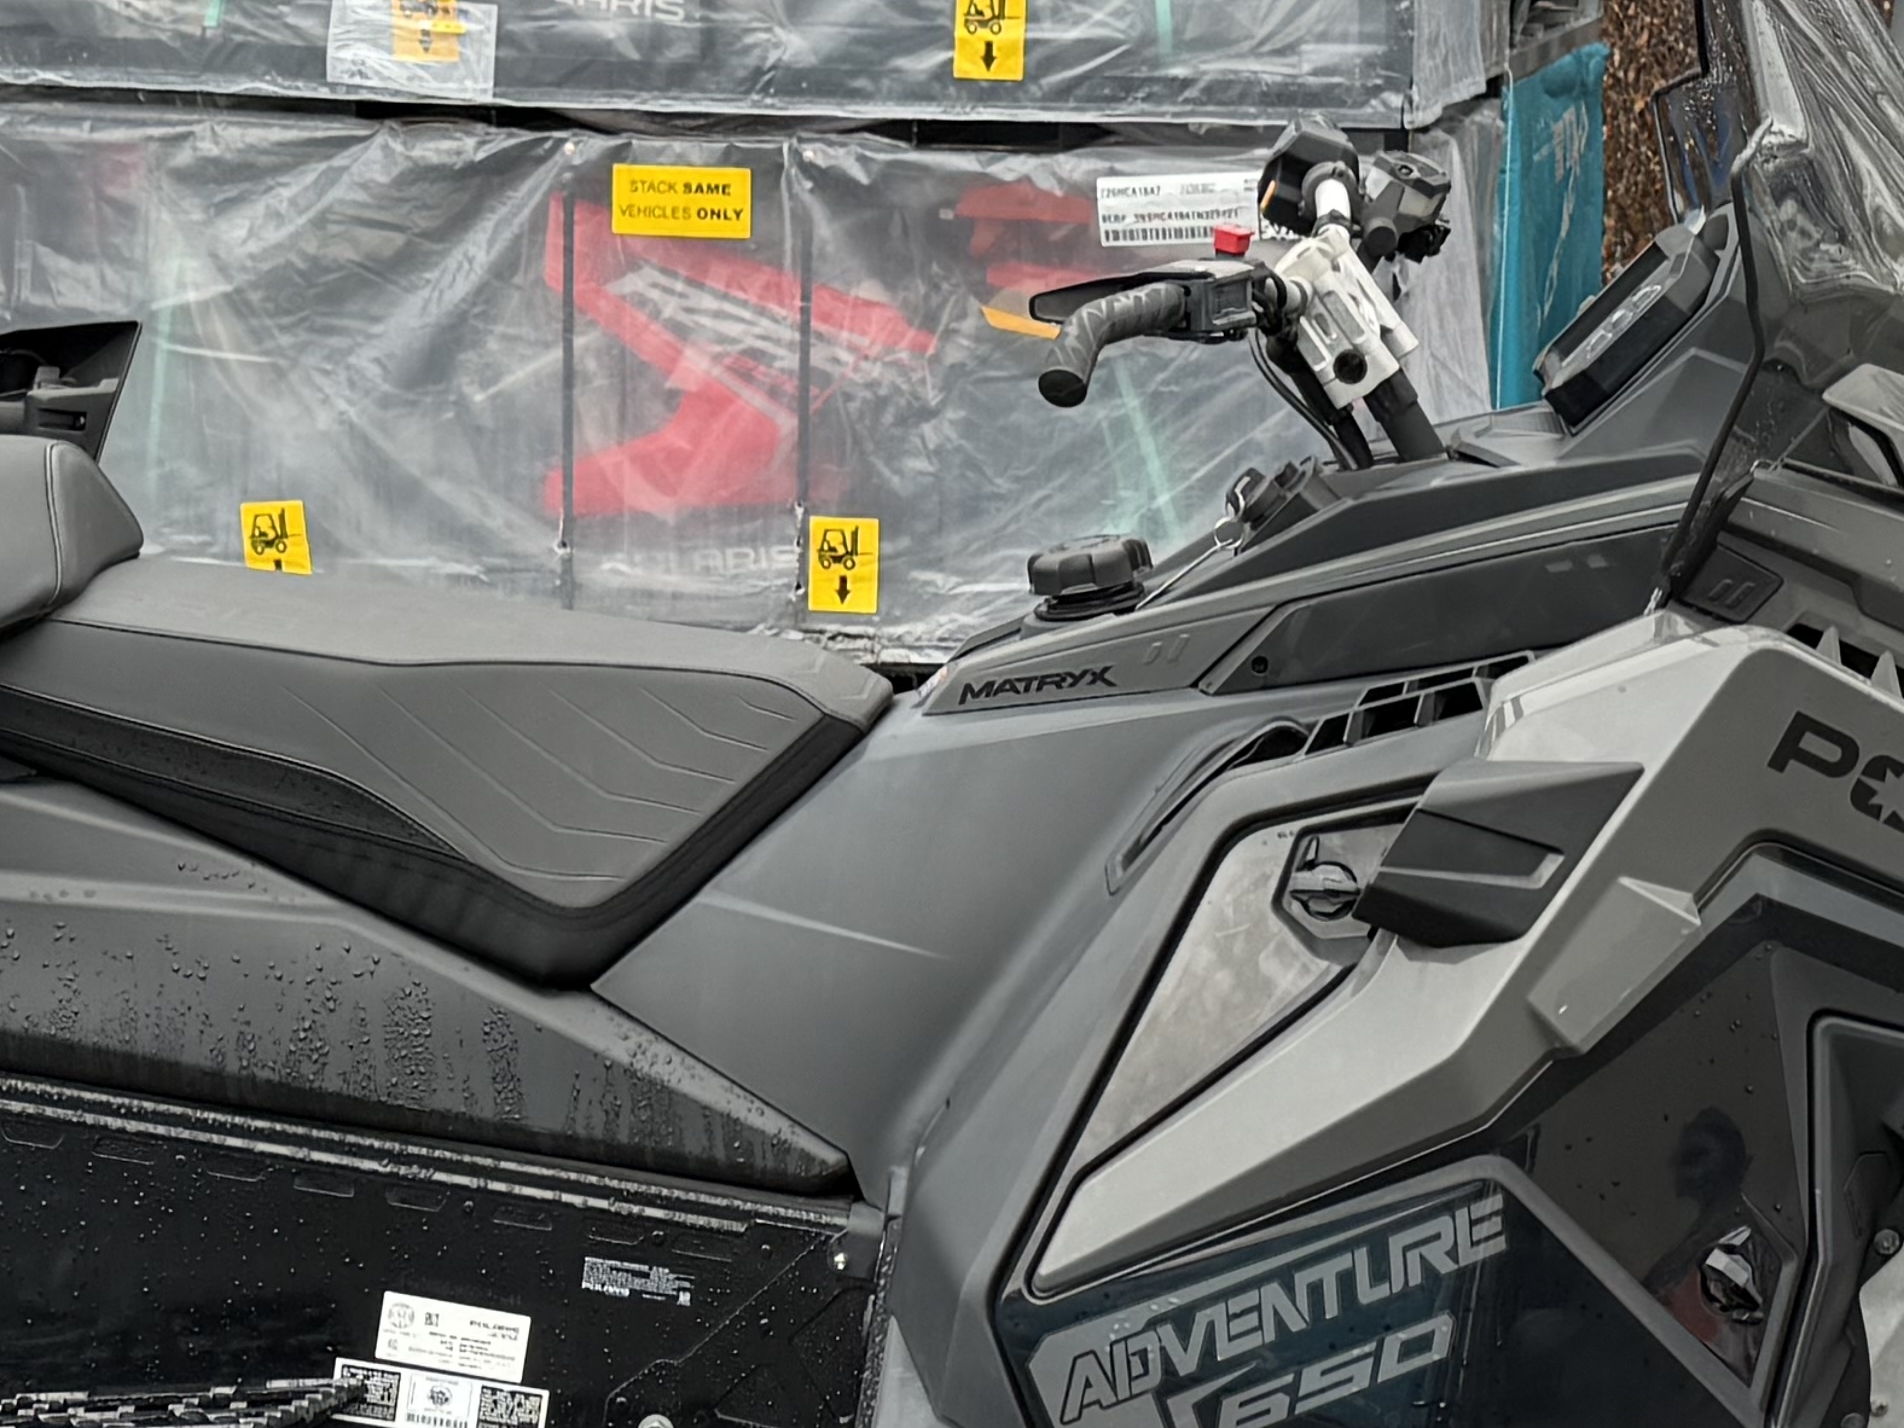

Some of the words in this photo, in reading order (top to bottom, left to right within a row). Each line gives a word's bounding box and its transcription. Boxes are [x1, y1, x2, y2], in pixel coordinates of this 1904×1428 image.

[682, 179, 732, 197] SAME
[697, 204, 745, 223] ONLY
[958, 664, 1118, 706] MATRYX
[1059, 1192, 1507, 1426] ADVENTURE
